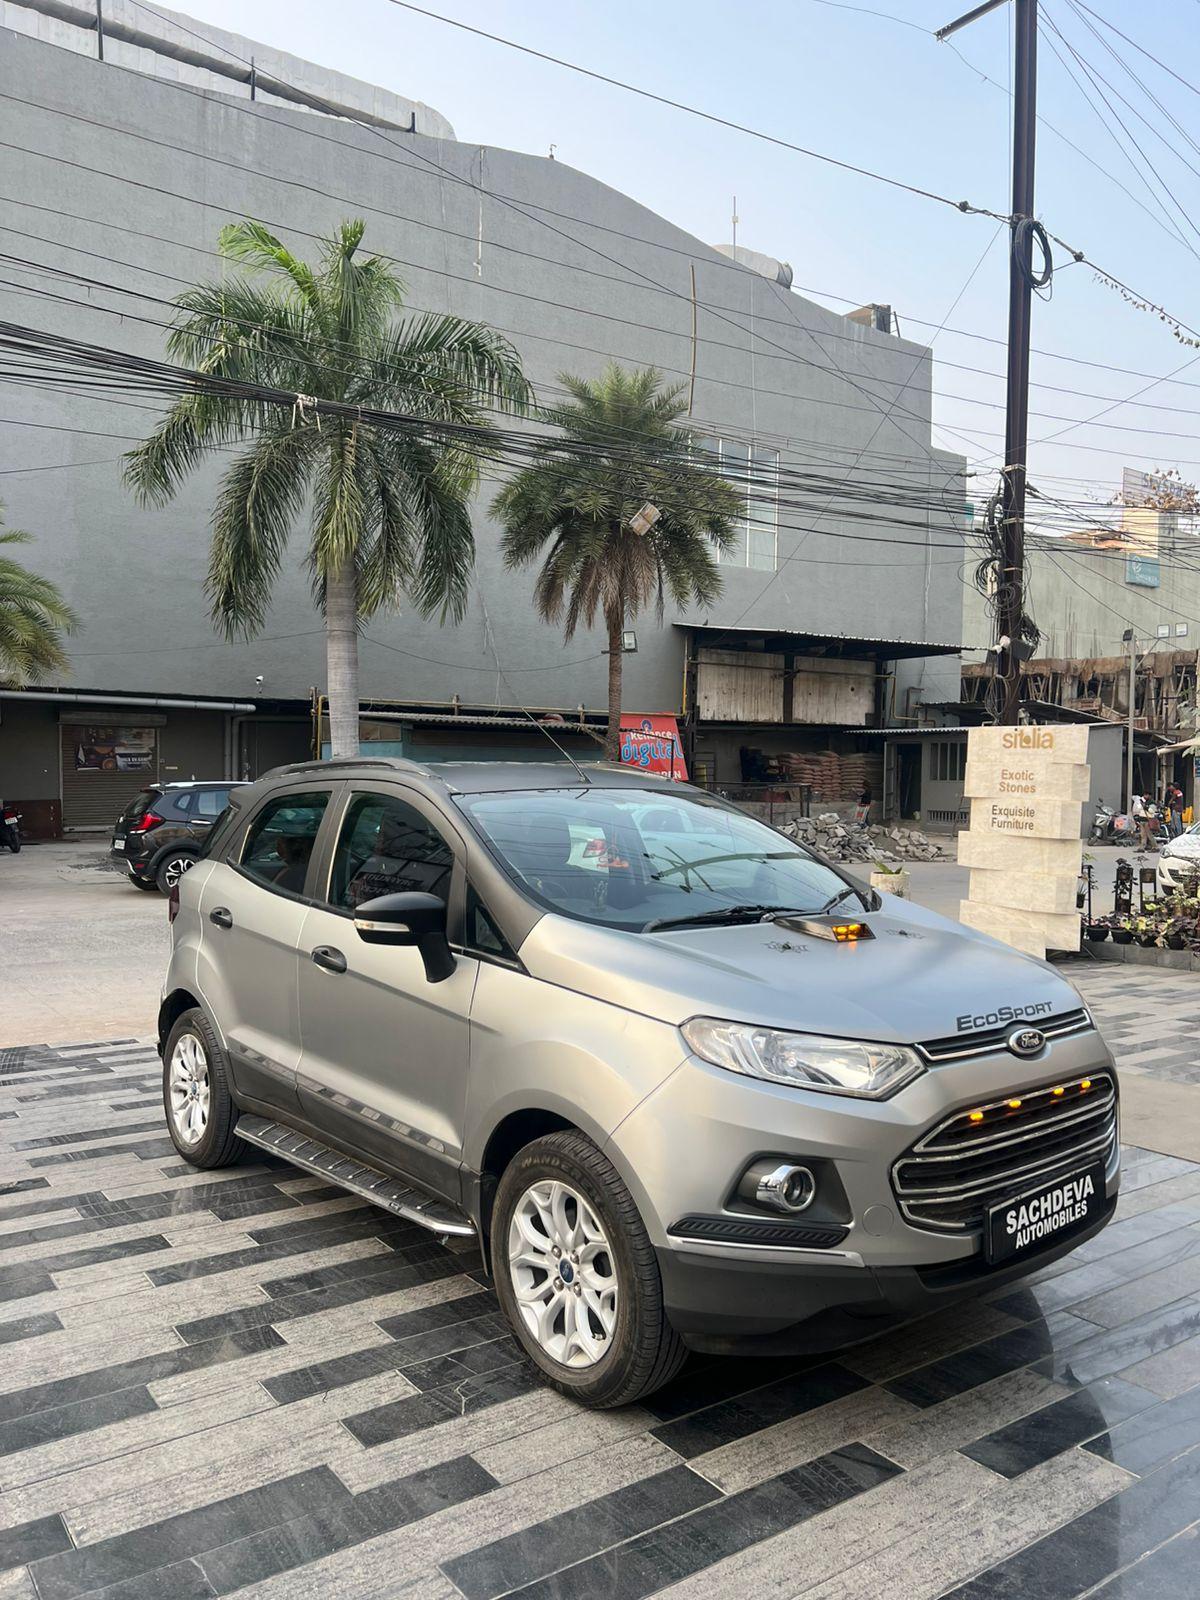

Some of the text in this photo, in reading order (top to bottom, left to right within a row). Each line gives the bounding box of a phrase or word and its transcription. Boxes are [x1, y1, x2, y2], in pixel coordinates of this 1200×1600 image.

[621, 733, 684, 767] digital
[1001, 769, 1035, 782] Exotic
[999, 782, 1036, 794] Stones
[992, 804, 1036, 818] Exquisite
[991, 817, 1035, 831] Furniture
[1019, 1032, 1041, 1048] Ford
[1006, 1174, 1095, 1235] SACHDEVA
[1015, 1200, 1088, 1250] AUTOMOBILES
